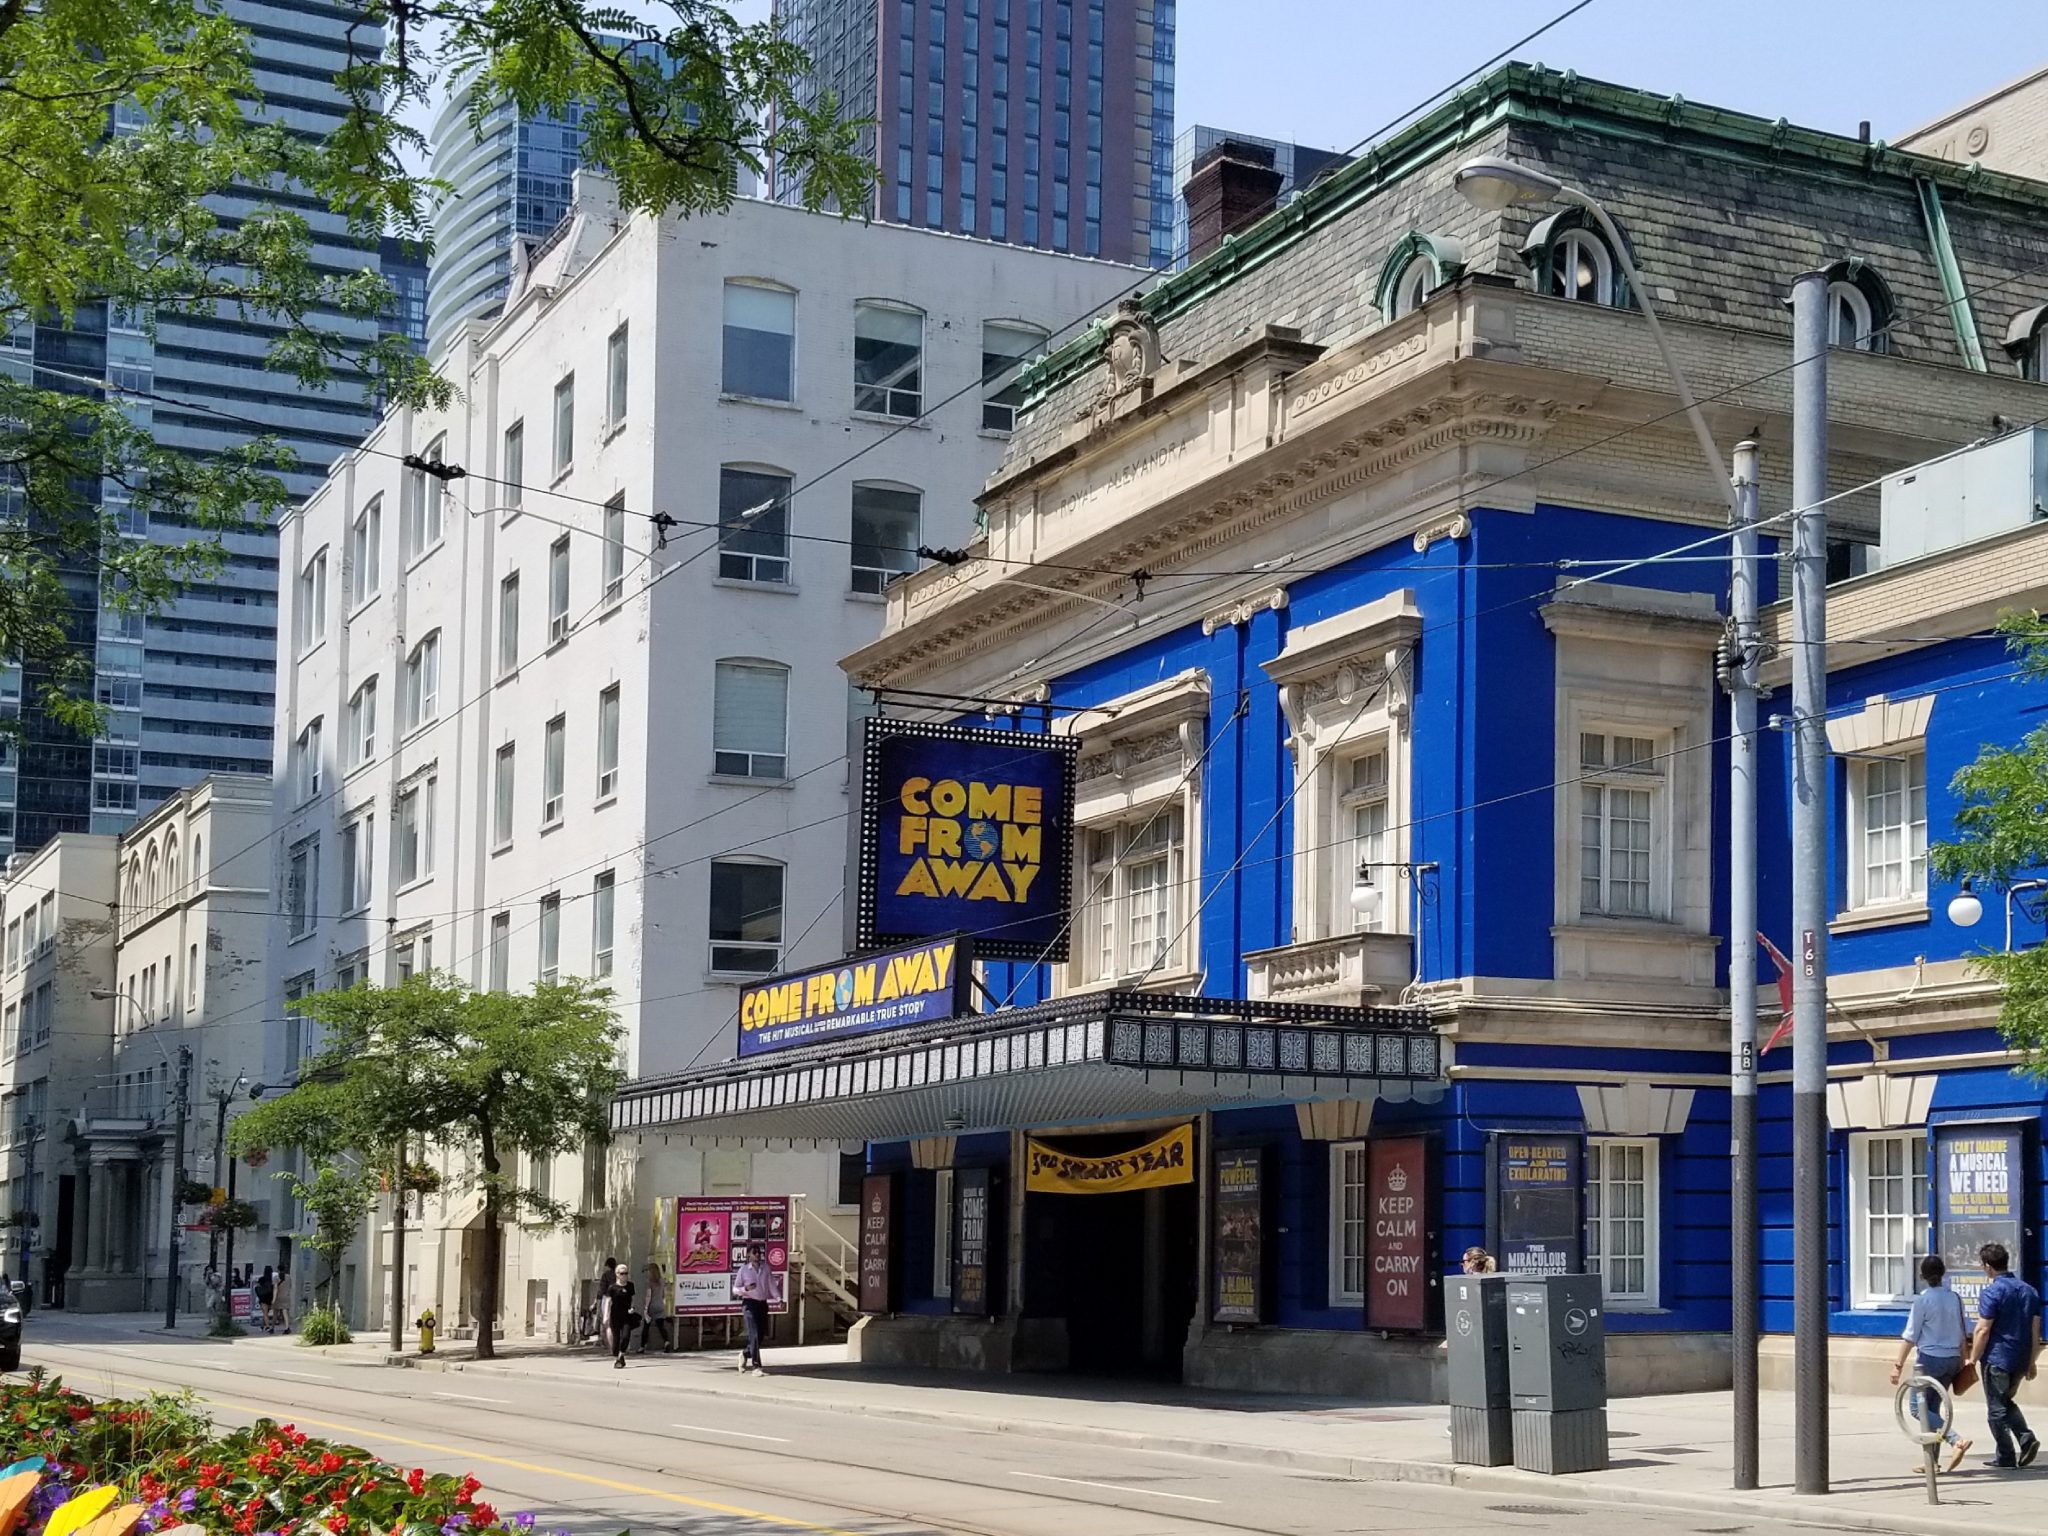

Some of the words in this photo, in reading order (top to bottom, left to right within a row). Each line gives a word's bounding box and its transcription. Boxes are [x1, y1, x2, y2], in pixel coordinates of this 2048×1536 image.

[1060, 485, 1098, 518] ROYAL
[1105, 438, 1187, 494] ALEXANDRA
[901, 777, 1042, 824] COME
[899, 816, 1042, 864] FROM
[895, 856, 1041, 903] AWAY
[741, 981, 803, 1031] COME
[805, 963, 876, 1018] FROM
[877, 944, 955, 1004] AWAY
[759, 1032, 771, 1044] THE
[772, 1029, 783, 1041] HIT
[784, 1024, 814, 1041] MUSICAL
[826, 1011, 875, 1031] REMARKABLE
[876, 1005, 897, 1021] TRUE
[898, 1000, 925, 1017] STORY
[1743, 1044, 1751, 1068] 68
[1128, 1141, 1184, 1174] YEAR
[1950, 1154, 1957, 1171] A
[1960, 1153, 2008, 1171] MUSICAL
[1220, 1167, 1257, 1184] POWERFUL
[1508, 1168, 1567, 1180] EXHILARATING
[1950, 1172, 1971, 1193] WE
[1975, 1171, 2008, 1193] NEED
[963, 1198, 984, 1218] COME
[1378, 1197, 1414, 1214] KEEP
[867, 1217, 885, 1229] KEEP
[962, 1219, 983, 1240] FROM
[1376, 1220, 1416, 1236] CALM
[865, 1233, 886, 1245] CALM
[1388, 1242, 1403, 1250] AND
[864, 1259, 886, 1271] CARRY
[962, 1250, 971, 1265] WE
[973, 1250, 982, 1265] ALL
[1375, 1256, 1420, 1273] CARRY
[1508, 1252, 1567, 1267] MIRACULOUS
[868, 1275, 880, 1287] ON
[1386, 1279, 1408, 1296] ON
